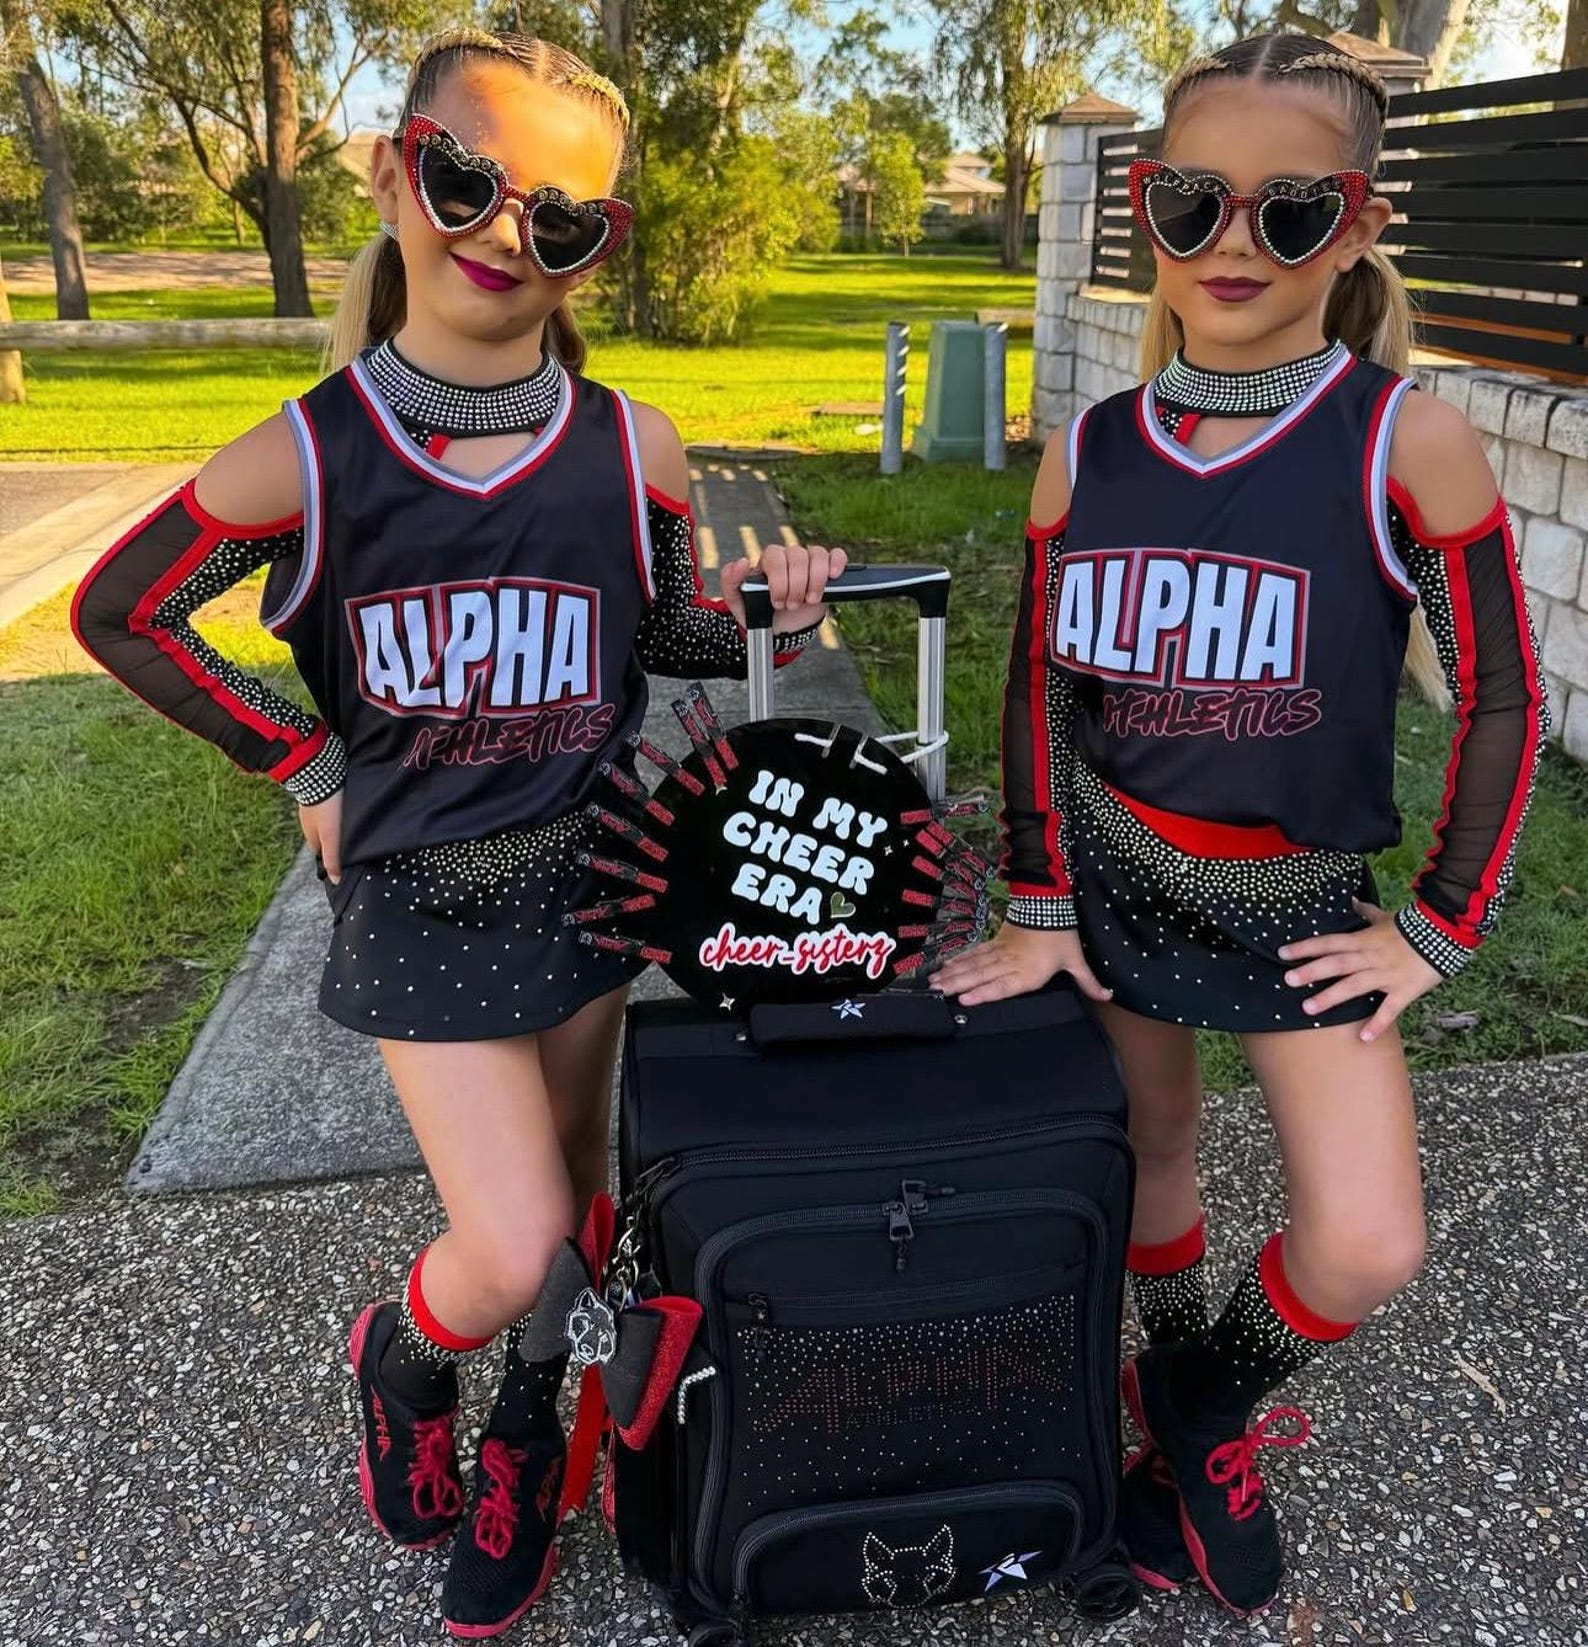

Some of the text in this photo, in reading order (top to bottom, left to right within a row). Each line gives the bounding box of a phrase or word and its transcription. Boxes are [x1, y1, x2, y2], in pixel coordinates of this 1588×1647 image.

[358, 588, 590, 708] ALPHA
[1055, 559, 1296, 680] ALPHA
[748, 769, 888, 848] IN MY
[723, 811, 875, 895] CHEER
[731, 862, 822, 925] ERA
